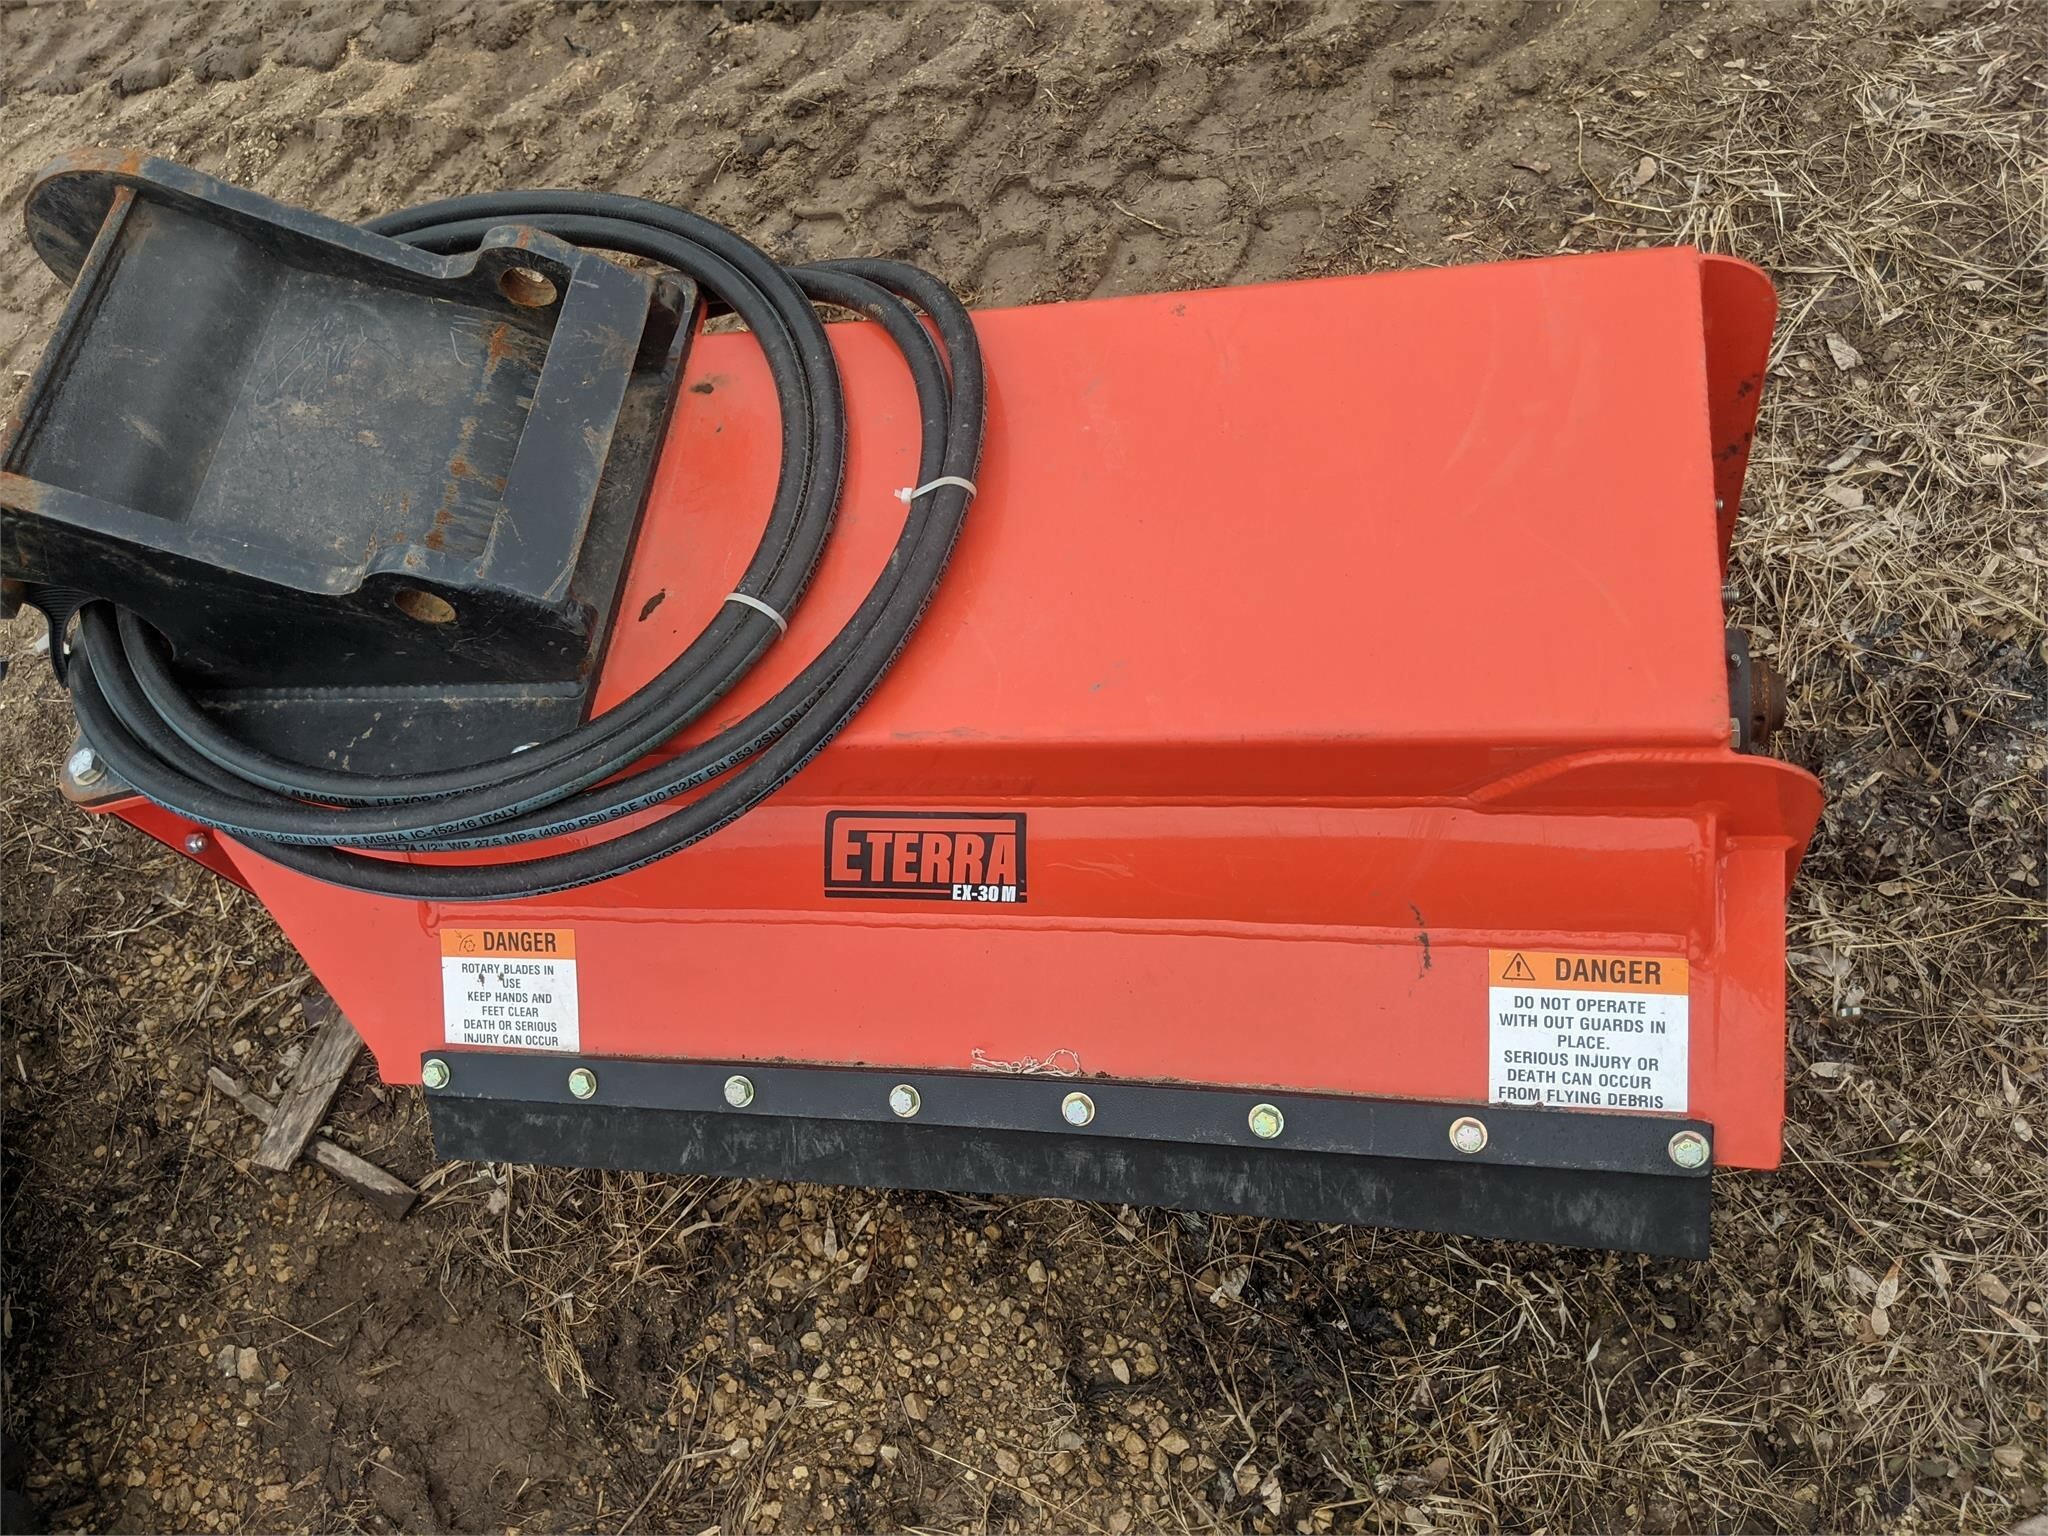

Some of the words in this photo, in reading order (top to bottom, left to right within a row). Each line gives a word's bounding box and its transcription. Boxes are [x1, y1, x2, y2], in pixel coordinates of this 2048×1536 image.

[445, 841, 470, 850] WP
[475, 838, 501, 848] 27.5
[504, 833, 537, 844] MPa
[540, 822, 577, 837] (4000
[579, 813, 607, 828] PSI)
[610, 802, 638, 818] SAE
[643, 791, 667, 806] 100
[668, 773, 703, 796] R2AT
[706, 762, 727, 777] EN
[728, 746, 753, 765] 853
[754, 727, 781, 748] 2SN
[782, 710, 801, 729] DN
[306, 836, 330, 845] DN
[333, 835, 360, 845] 12.5
[362, 832, 408, 844] MSHA
[410, 820, 477, 840] IC-152/16
[479, 806, 518, 825] ITALY
[831, 818, 1017, 884] ETERRA
[483, 931, 557, 952] DANGER
[462, 963, 500, 974] ROTARY
[504, 964, 540, 975] BLADES
[544, 965, 554, 975] IN
[1555, 957, 1661, 985] DANGER
[502, 978, 521, 989] USE
[467, 991, 491, 1002] KEEP
[495, 992, 528, 1003] HANDS
[532, 993, 552, 1004] AND
[1514, 995, 1534, 1009] DO
[1540, 997, 1571, 1011] NOT
[1576, 998, 1647, 1015] OPERATE
[482, 1006, 504, 1016] FEET
[508, 1007, 539, 1017] CLEAR
[464, 1019, 495, 1030] DEATH
[499, 1020, 512, 1031] OR
[515, 1021, 557, 1032] SERIOUS
[1499, 1013, 1538, 1028] WITH
[1543, 1015, 1574, 1029] OUT
[1580, 1017, 1644, 1034] GUARDS
[1650, 1021, 1666, 1034] IN
[464, 1033, 499, 1044] INJURY
[502, 1034, 522, 1045] CAN
[525, 1035, 559, 1046] OCCUR
[1557, 1035, 1610, 1050] PLACE.
[1504, 1050, 1568, 1067] SERIOUS
[1575, 1054, 1632, 1070] INJURY
[1637, 1057, 1659, 1071] OR
[1507, 1069, 1556, 1084] DEATH
[1562, 1072, 1592, 1086] CAN
[1599, 1074, 1652, 1090] OCCUR
[1498, 1086, 1540, 1101] FROM
[1547, 1089, 1601, 1105] FLYING
[1608, 1093, 1664, 1109] DEBRIS
